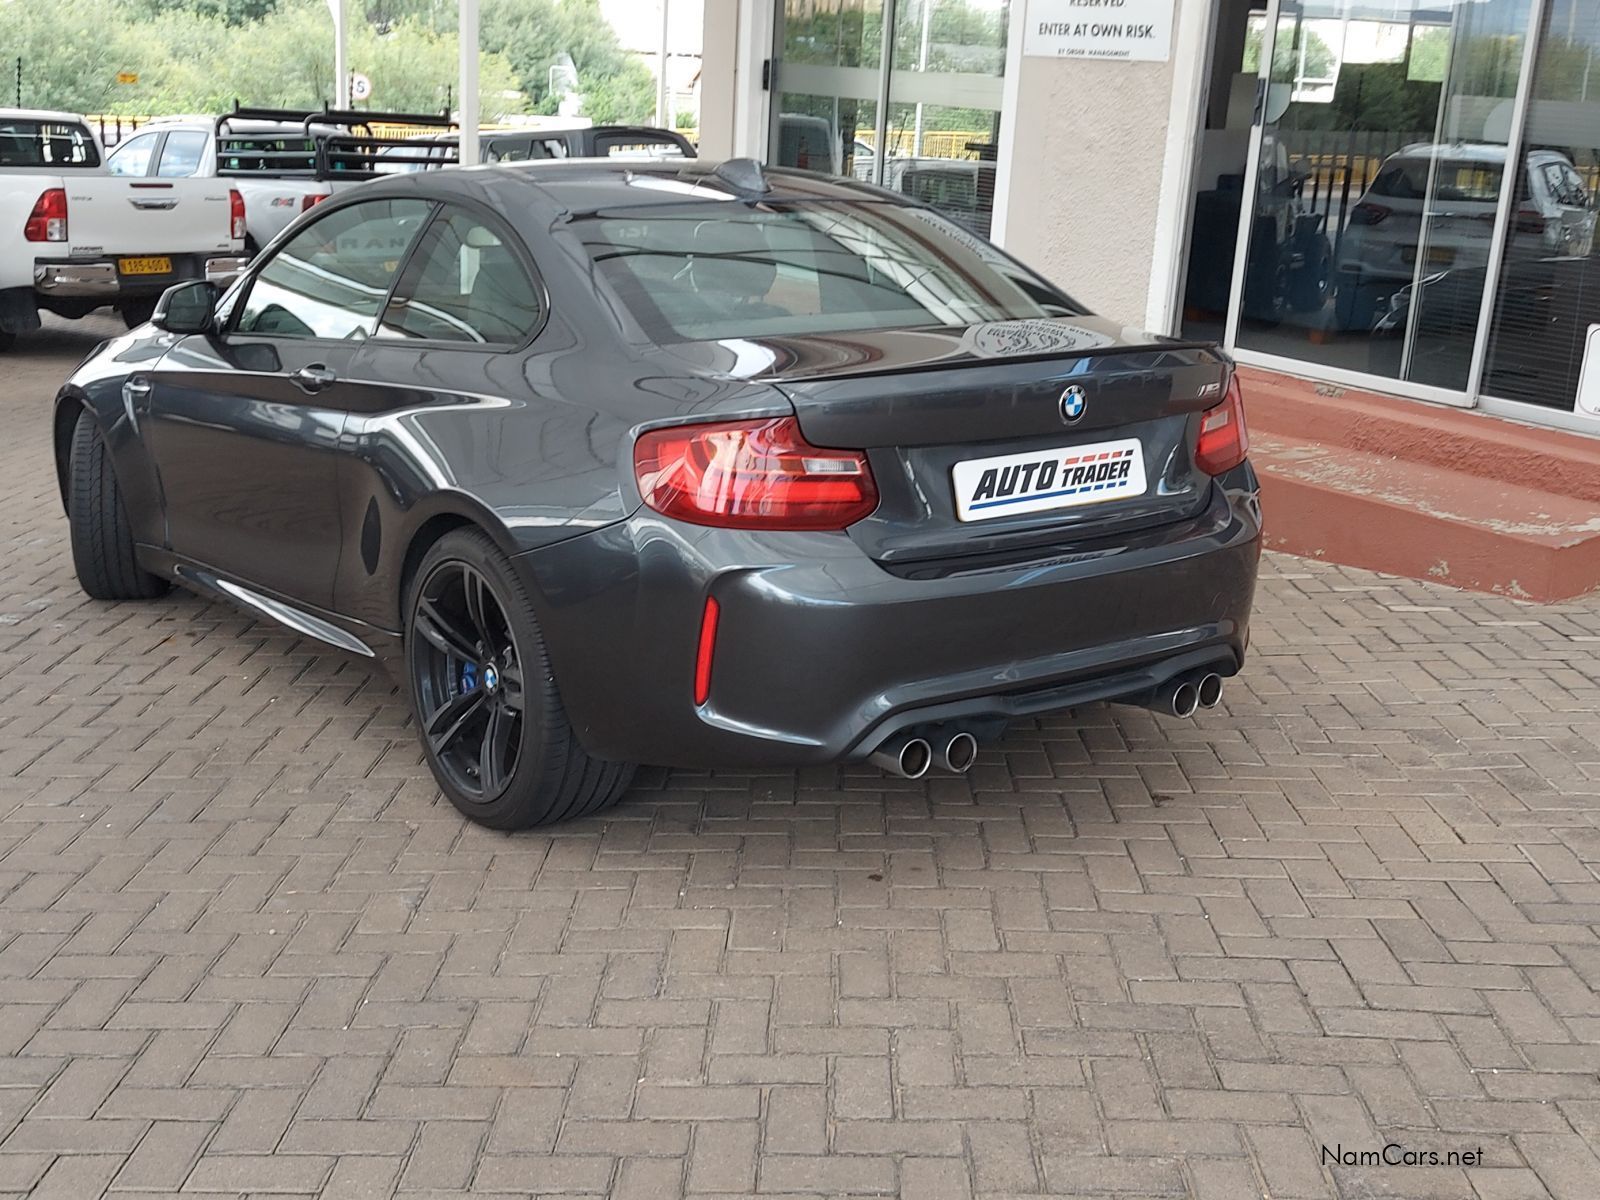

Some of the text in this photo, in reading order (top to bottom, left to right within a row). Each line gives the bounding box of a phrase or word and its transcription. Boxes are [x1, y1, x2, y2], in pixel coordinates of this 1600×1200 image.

[1038, 22, 1156, 38] ENTER AT OWN RISK.
[972, 459, 1131, 501] AUTO TRADER
